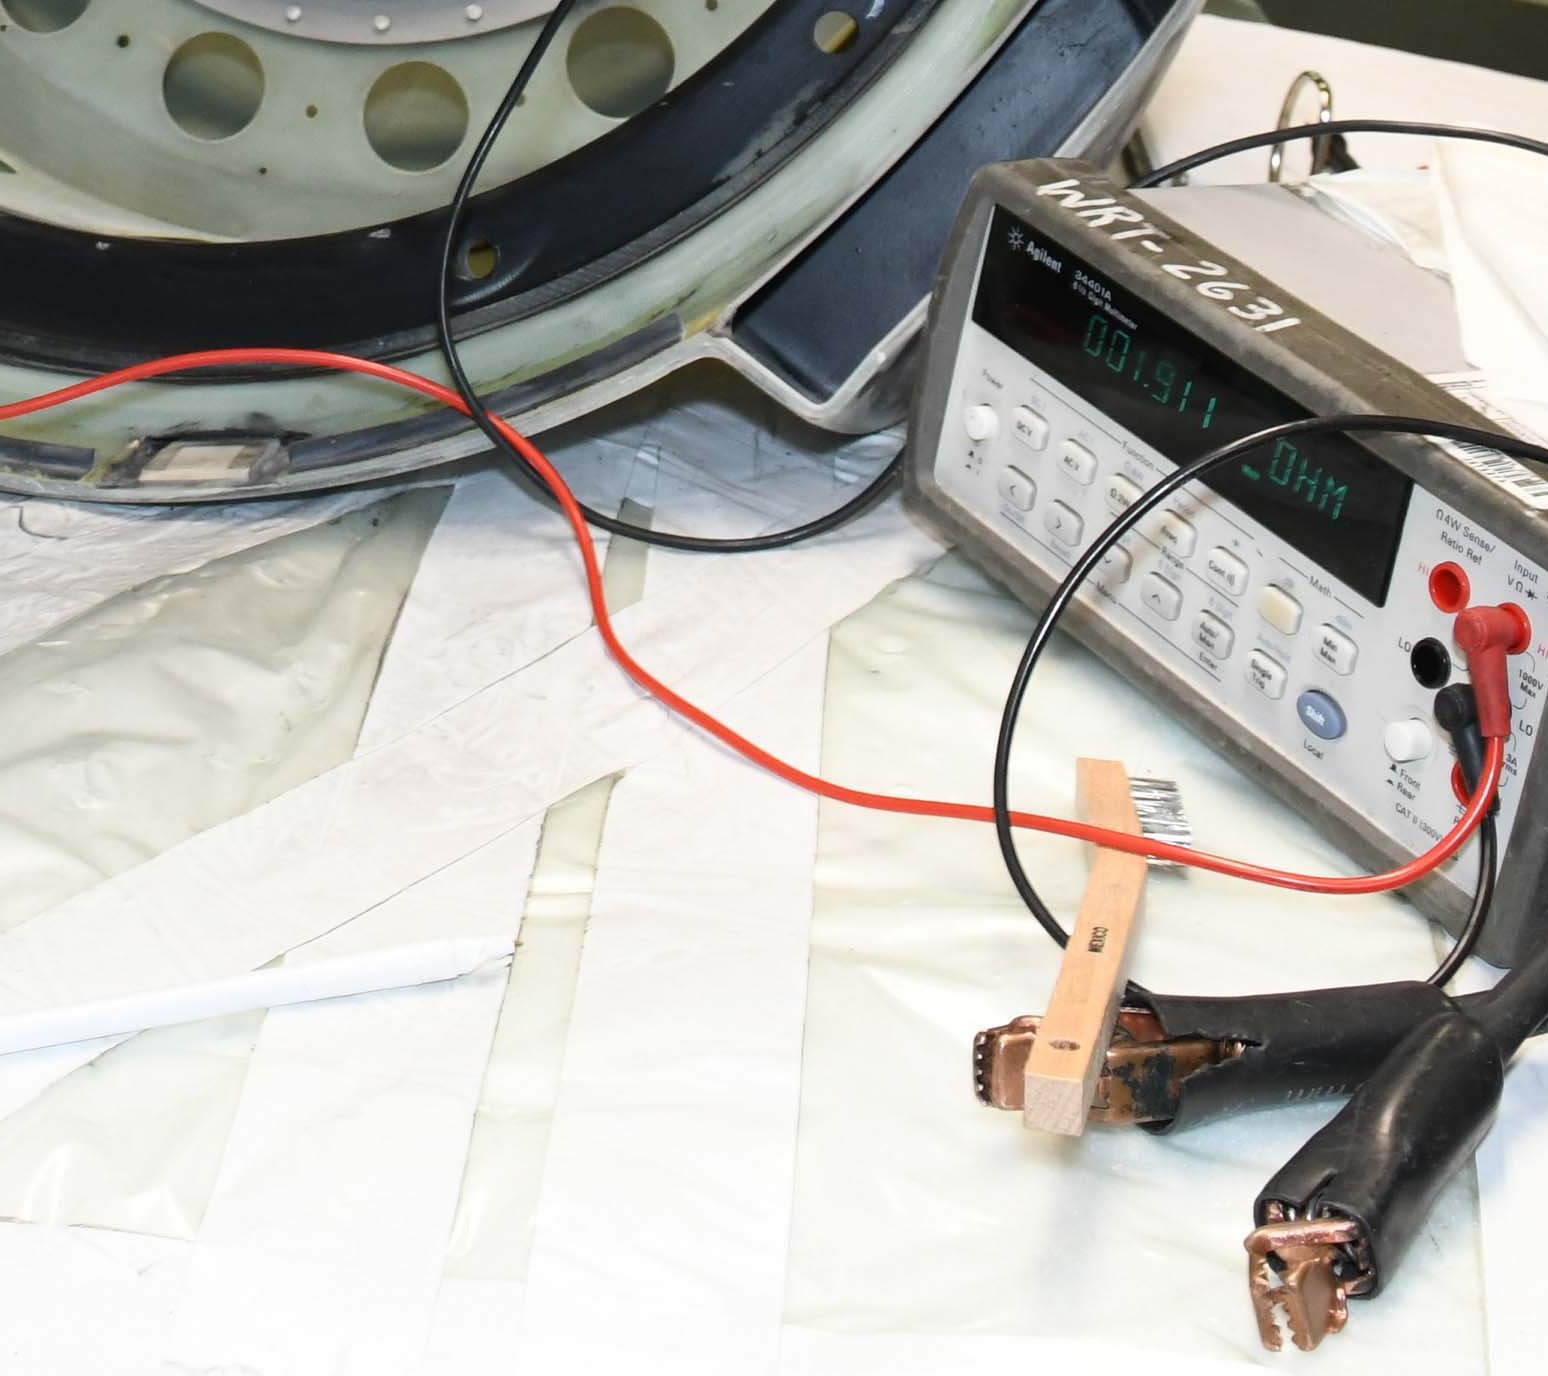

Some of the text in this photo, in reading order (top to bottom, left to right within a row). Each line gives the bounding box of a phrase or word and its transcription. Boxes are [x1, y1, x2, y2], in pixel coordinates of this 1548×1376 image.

[1026, 240, 1063, 274] Agilent
[1074, 269, 1112, 302] 34401A
[1121, 440, 1154, 470] Function
[1439, 529, 1483, 566] Ratio Ref
[1462, 525, 1497, 554] Sense/
[1417, 561, 1431, 575] HI
[1513, 559, 1540, 585] Input
[1308, 575, 1333, 599] Math
[1518, 667, 1544, 691] 1000V
[1519, 680, 1537, 699] Max
[1305, 704, 1326, 727] Shift
[1518, 718, 1534, 738] LO
[1303, 737, 1325, 761] Local
[1396, 781, 1417, 802] Rear
[1399, 767, 1422, 792] Front
[1394, 802, 1412, 821] CAT
